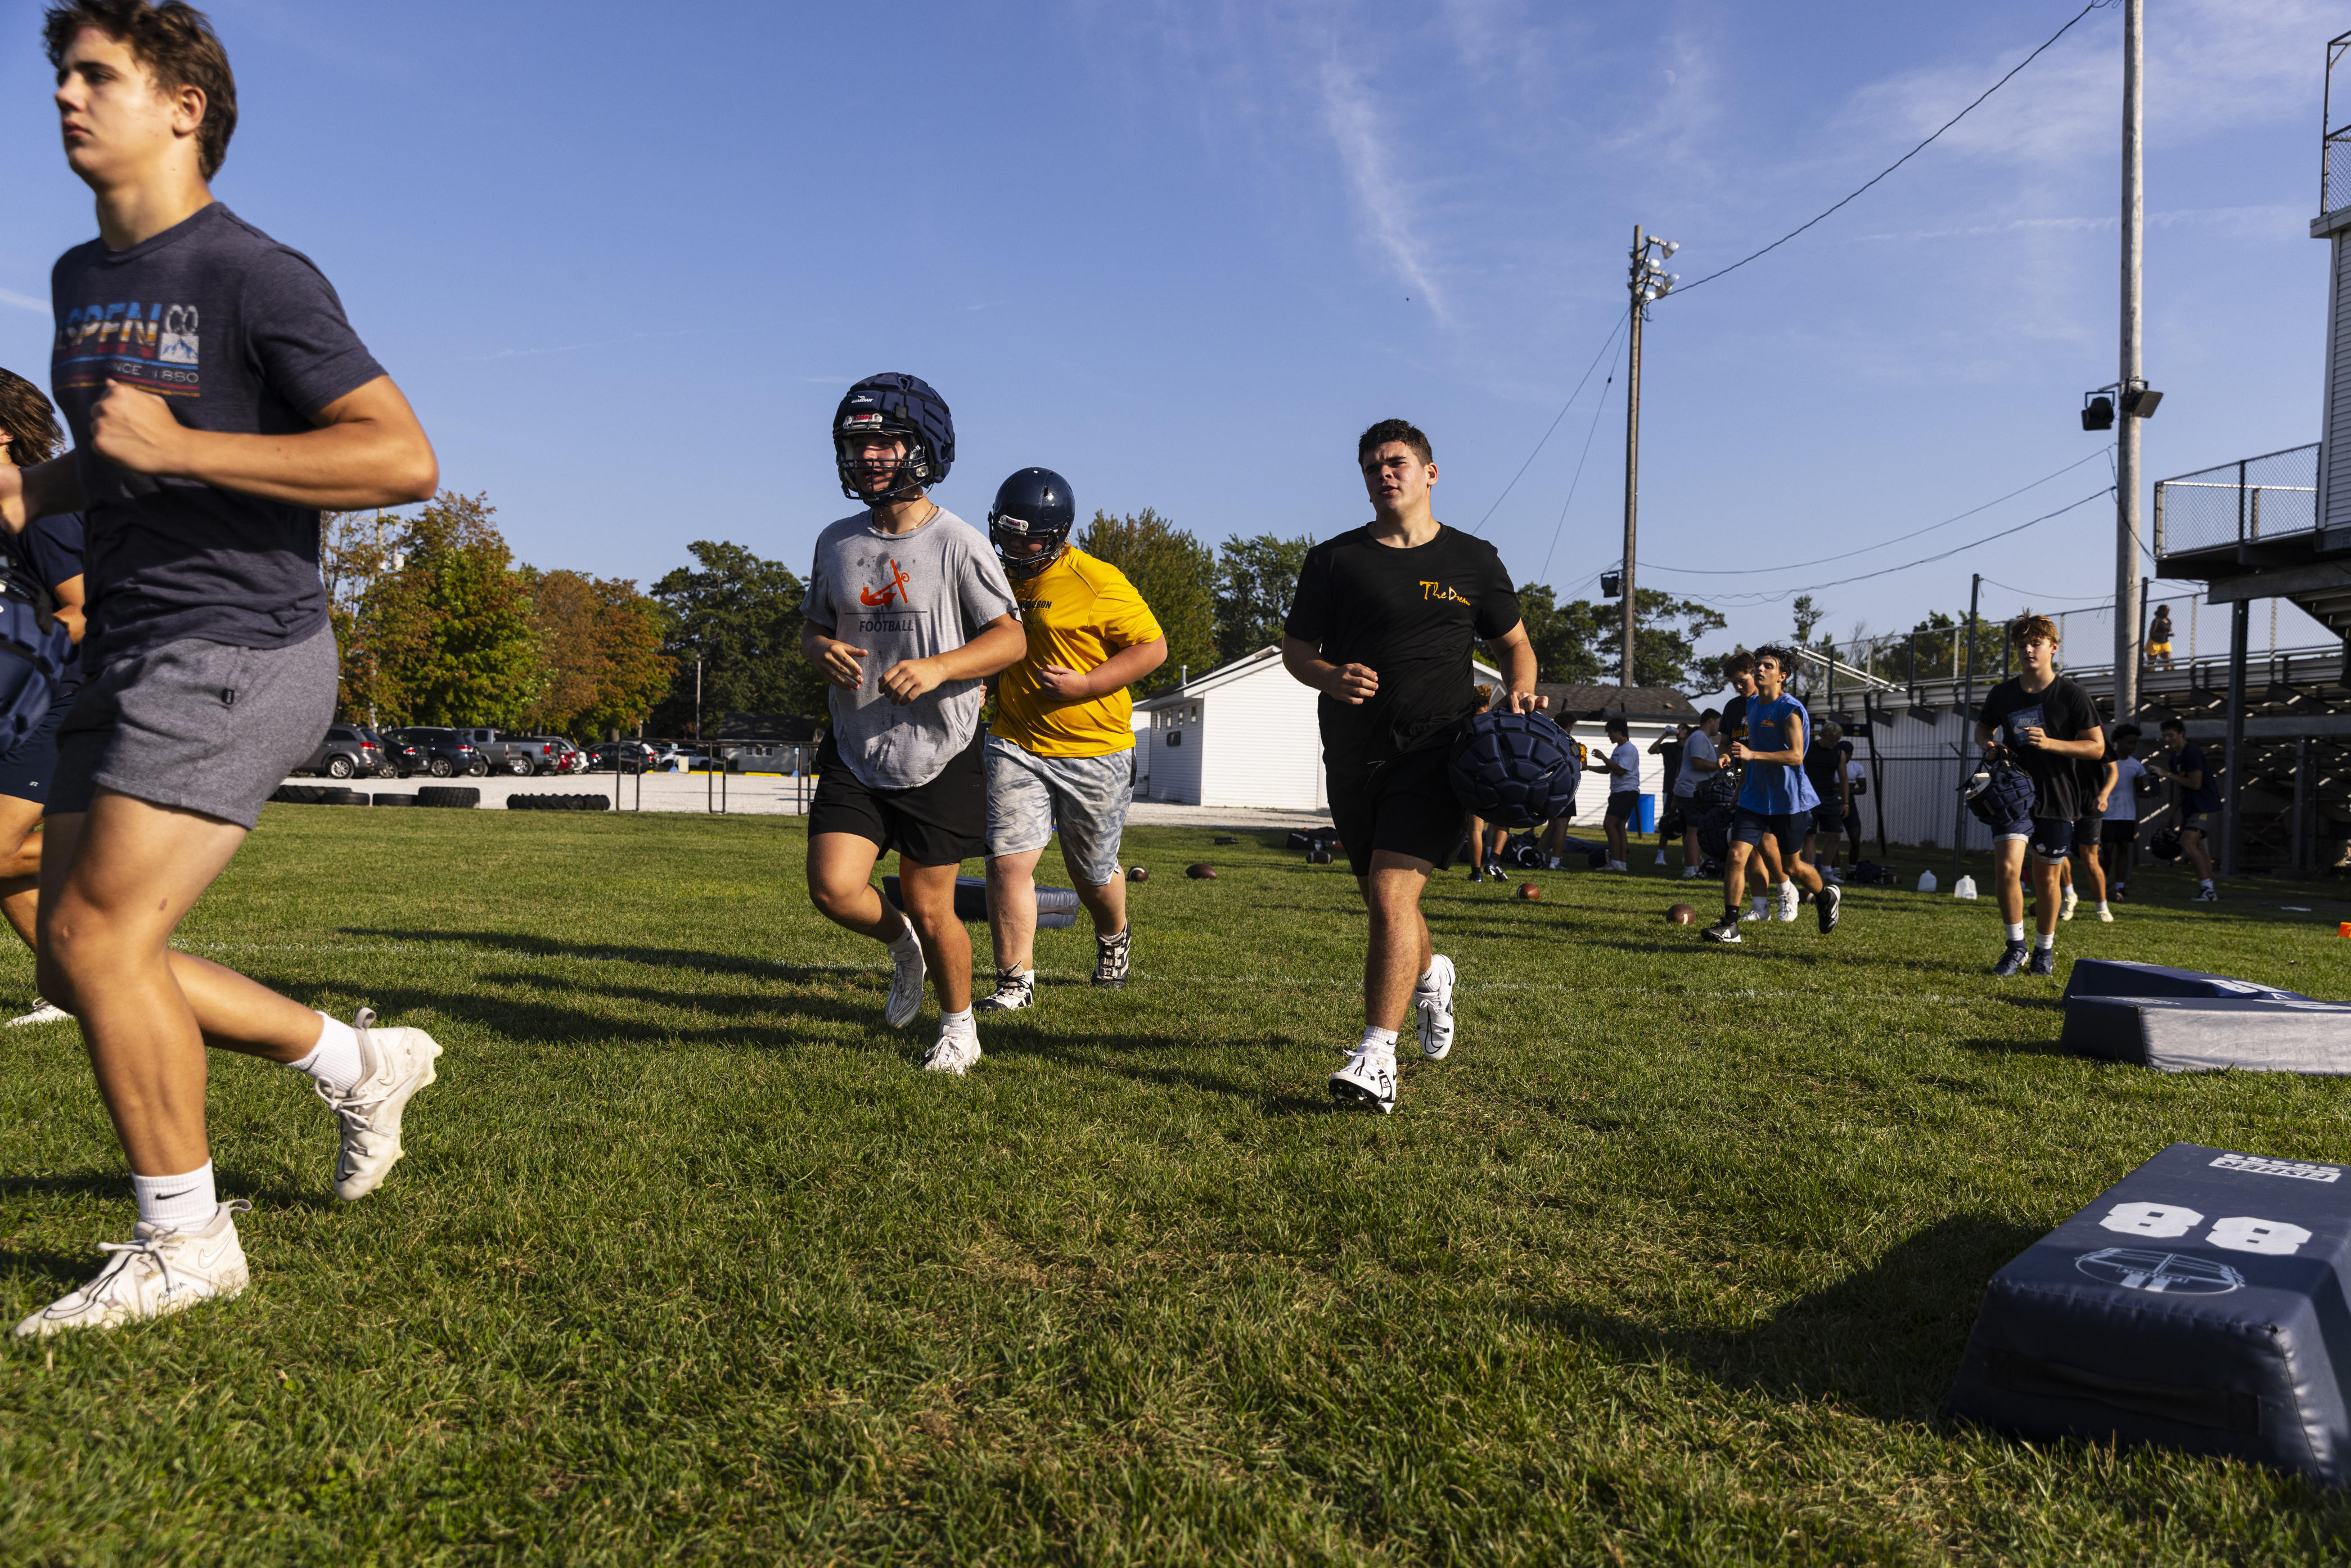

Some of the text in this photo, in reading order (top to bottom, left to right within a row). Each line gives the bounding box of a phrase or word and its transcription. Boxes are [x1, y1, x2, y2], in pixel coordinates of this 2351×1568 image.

[152, 368, 199, 383] 1880
[1420, 580, 1470, 606] The Dream
[859, 620, 914, 632] FOOTBALL
[2017, 718, 2037, 727] NIKE
[2217, 1161, 2331, 1179] FISHER
[2098, 1201, 2313, 1255] 88
